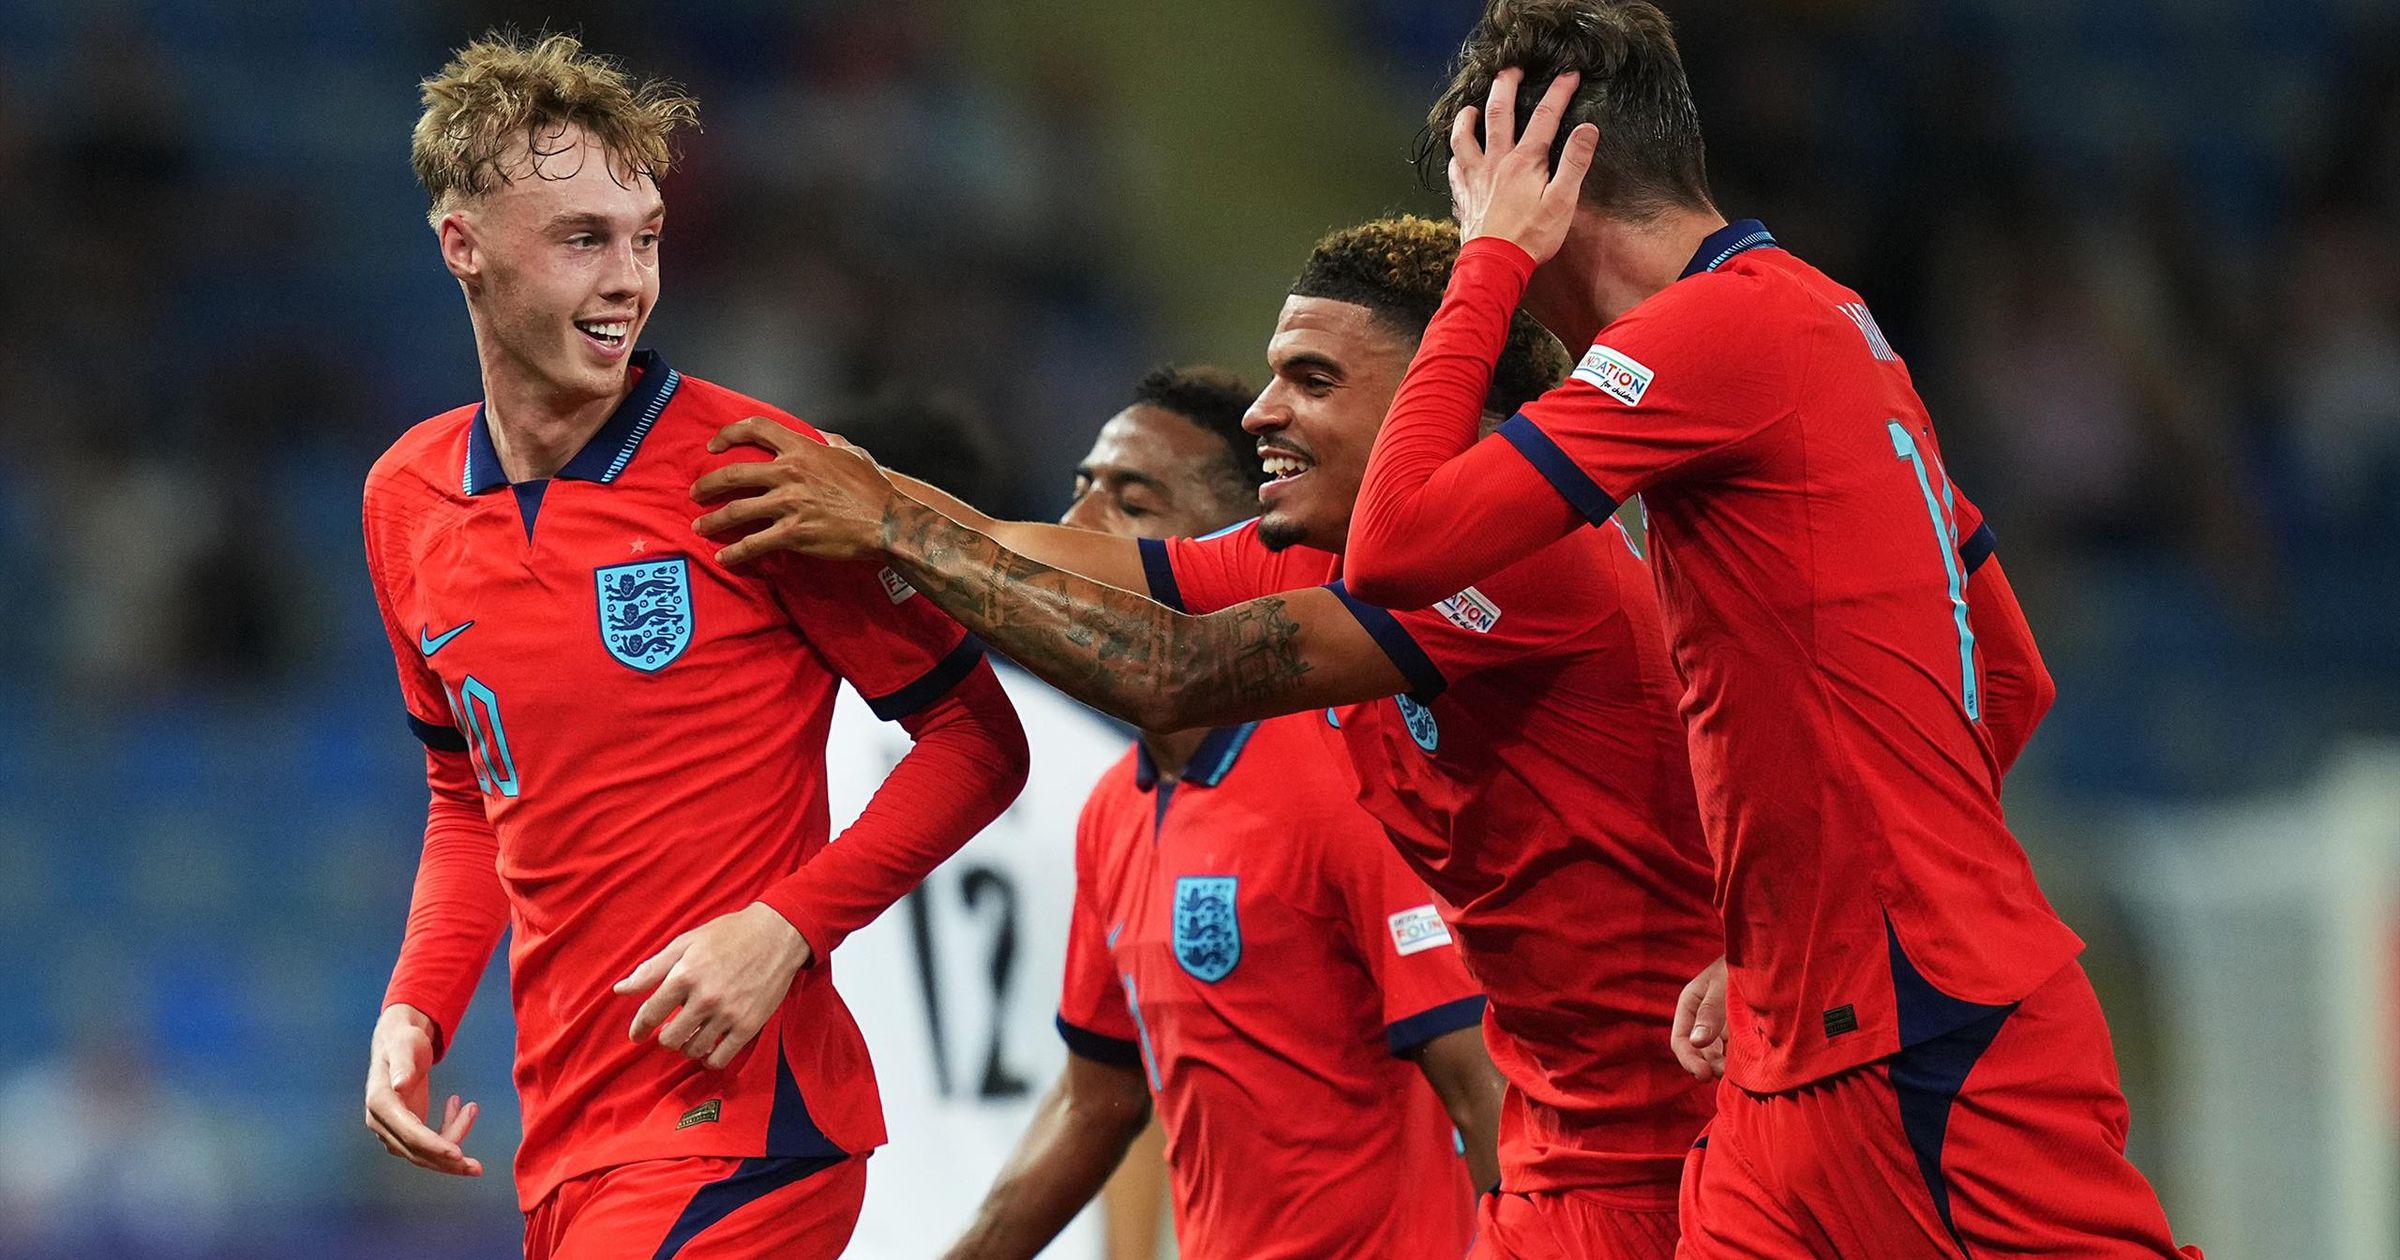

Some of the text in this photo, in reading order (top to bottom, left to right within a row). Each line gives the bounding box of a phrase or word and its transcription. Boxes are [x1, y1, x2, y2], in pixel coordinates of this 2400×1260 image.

[1600, 379, 1635, 404] for children
[1886, 418, 1980, 722] 1
[908, 866, 1032, 1100] 12
